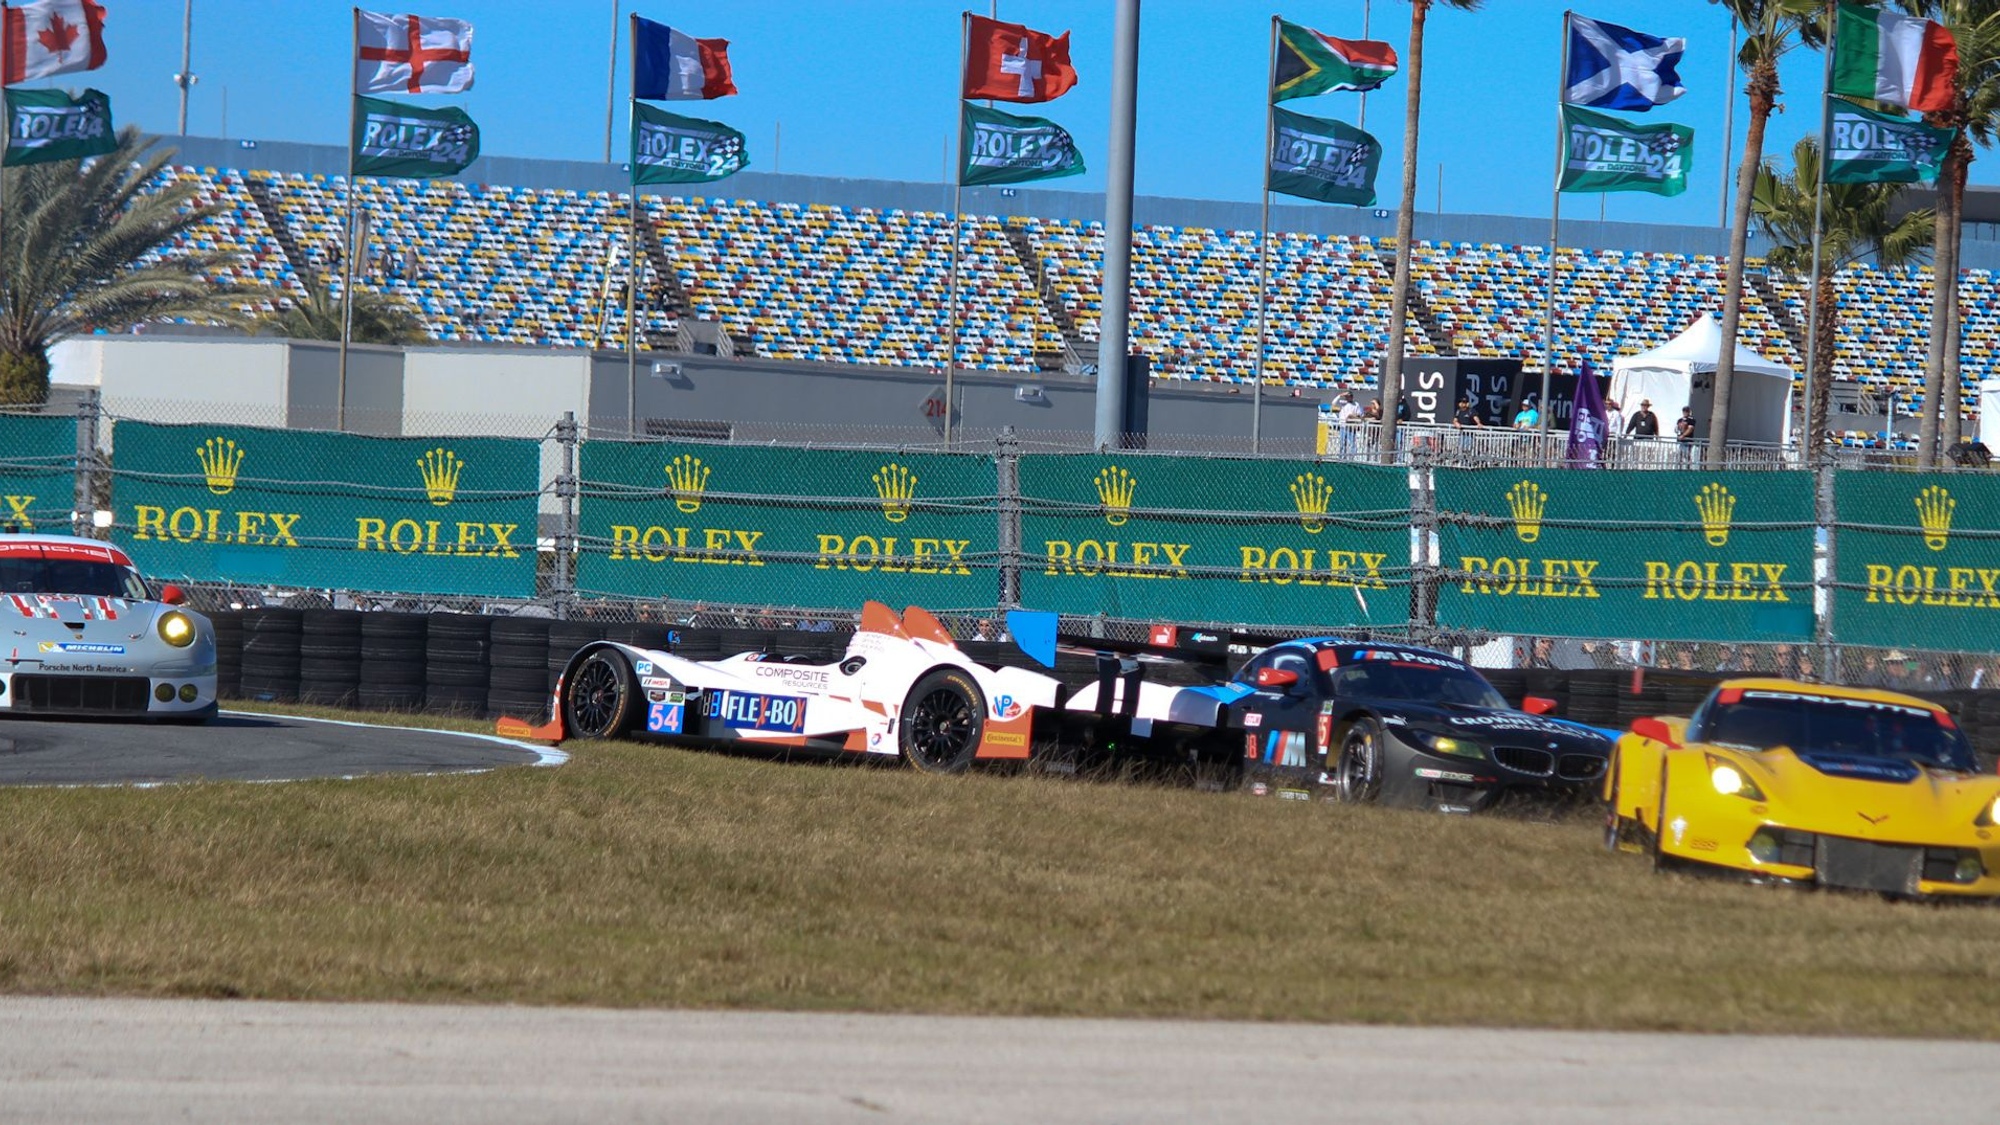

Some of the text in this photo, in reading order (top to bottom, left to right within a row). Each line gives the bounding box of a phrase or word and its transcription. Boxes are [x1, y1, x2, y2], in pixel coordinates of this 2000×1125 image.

[12, 113, 86, 138] ROLE
[361, 120, 443, 151] ROLEX
[430, 142, 469, 164] 24
[637, 129, 712, 163] ROLEX
[972, 129, 1054, 159] ROLEX
[1276, 134, 1354, 174] ROLEX
[706, 155, 740, 176] 24
[1335, 165, 1367, 189] 24
[1646, 154, 1682, 179] 24
[133, 505, 301, 547] ROLEX
[355, 517, 520, 558] ROLEX
[0, 544, 109, 559] ORSCHE
[609, 525, 765, 567] ROLEX
[815, 535, 971, 575] ROLEX
[1045, 540, 1191, 580] ROLEX
[1240, 546, 1387, 589] ROLEX
[1461, 556, 1600, 598] ROLEX
[1644, 561, 1789, 602] ROLEX
[1865, 564, 2000, 608] ROLEX
[65, 644, 123, 652] MICHELIN
[1400, 652, 1467, 671] Power
[39, 663, 127, 673] Porsche North America
[637, 663, 651, 673] PC
[755, 666, 830, 683] COMPOSITE
[781, 680, 829, 690] RESOURCES
[649, 704, 679, 732] 54
[726, 695, 806, 731] FLEX-BOX
[994, 694, 1013, 718] VP
[1450, 715, 1537, 727] CROWNE
